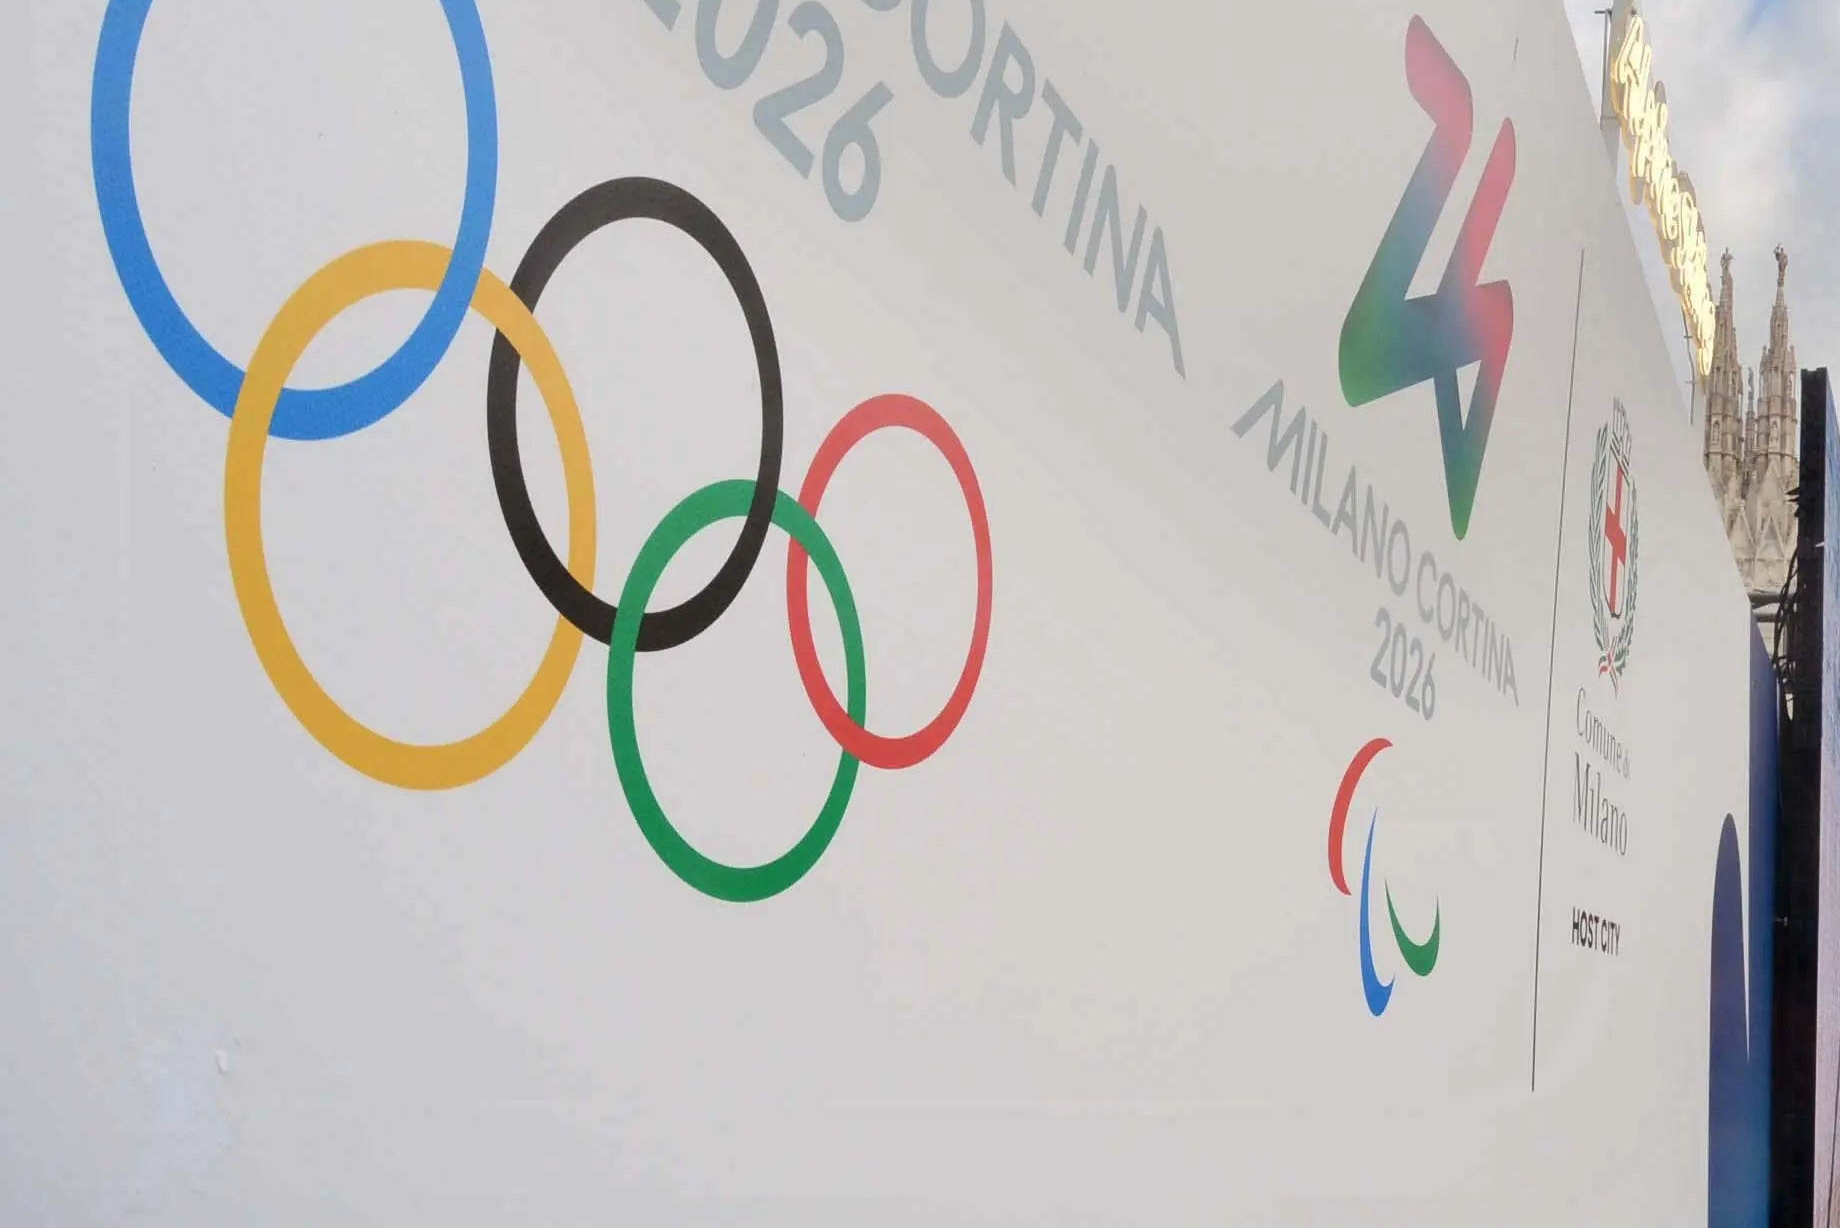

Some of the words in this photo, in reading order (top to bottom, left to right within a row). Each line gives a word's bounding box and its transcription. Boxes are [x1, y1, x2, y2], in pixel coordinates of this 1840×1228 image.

[1231, 378, 1410, 597] MILANO
[1416, 551, 1519, 707] CORTINA
[1370, 607, 1436, 721] 2026
[1576, 686, 1622, 773] Comune
[1572, 751, 1627, 856] Milano
[1571, 905, 1600, 949] HOST
[1600, 919, 1621, 957] CITY
